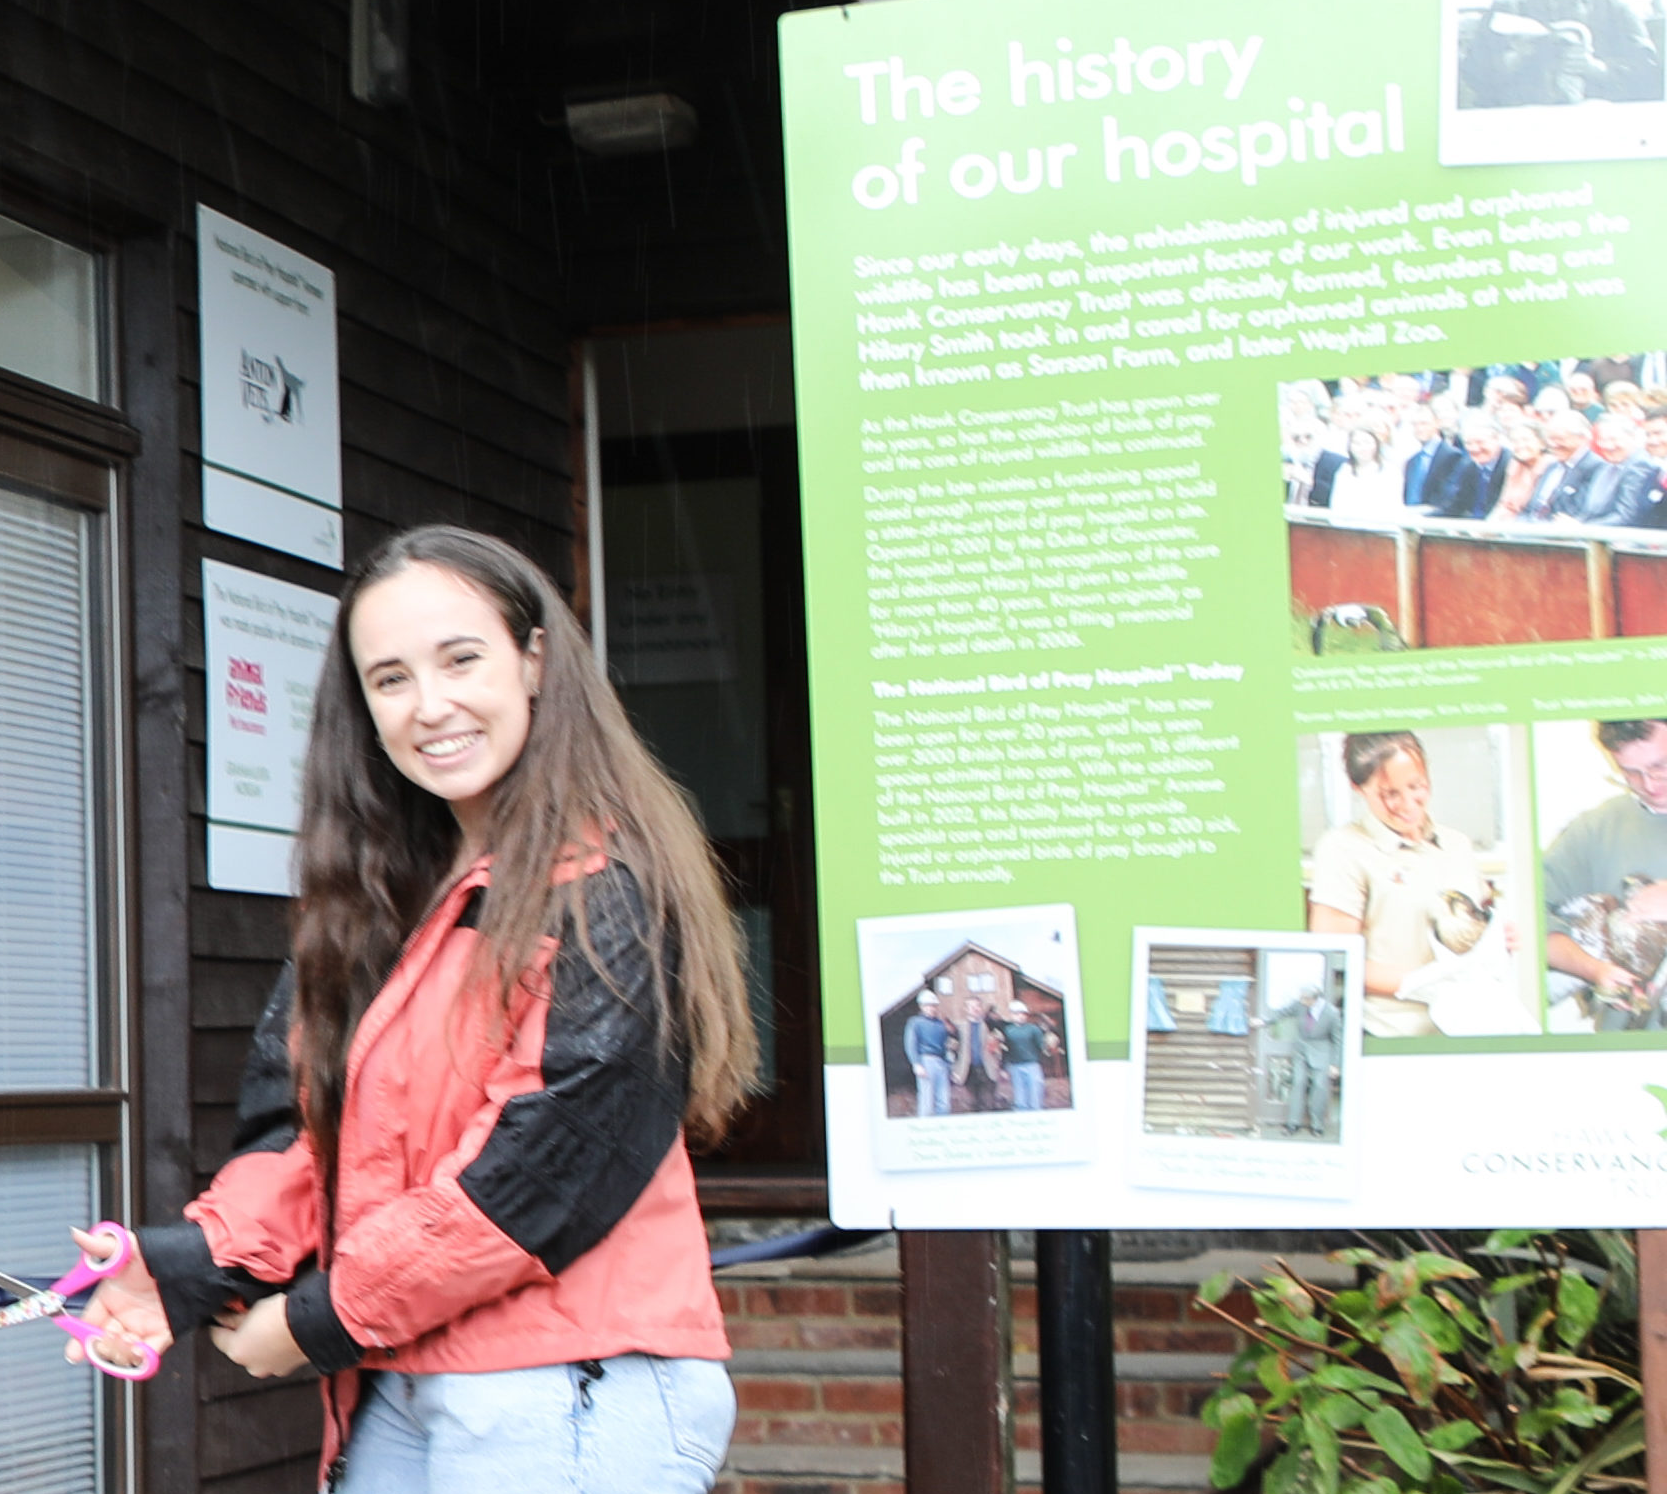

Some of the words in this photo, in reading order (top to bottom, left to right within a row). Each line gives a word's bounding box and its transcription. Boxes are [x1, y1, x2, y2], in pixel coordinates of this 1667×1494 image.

[842, 55, 982, 125] The
[1008, 35, 1265, 107] history
[850, 136, 927, 210] of
[949, 141, 1078, 199] our
[1101, 82, 1405, 187] hospital
[853, 256, 913, 278] Since
[917, 252, 957, 272] our
[962, 242, 1020, 267] early
[1088, 232, 1129, 254] the
[1291, 211, 1319, 233] of
[1323, 202, 1410, 232] injured
[1414, 197, 1465, 221] and
[1469, 184, 1594, 217] orphaned
[854, 279, 933, 306] wildlife
[937, 276, 980, 298] has
[984, 272, 1043, 293] been
[1047, 269, 1080, 287] an
[1084, 252, 1199, 284] important
[1204, 247, 1272, 272] factor
[1278, 242, 1305, 264] of
[1309, 242, 1351, 261] our
[1431, 228, 1494, 250] Even
[1498, 219, 1582, 243] before
[1588, 212, 1630, 235] the
[856, 308, 922, 334] Hawk
[926, 298, 1072, 328] Conservancy
[1078, 288, 1133, 313] Trust
[1138, 288, 1185, 307] was
[1393, 257, 1503, 284] founders
[1562, 243, 1615, 268] and
[857, 339, 925, 362] Hilary
[929, 330, 994, 356] Smith
[998, 325, 1050, 350] took
[1054, 323, 1079, 345] in
[1082, 318, 1130, 342] and
[1134, 311, 1203, 337] cared
[1206, 309, 1241, 331] for
[1246, 296, 1366, 328] orphaned
[1370, 288, 1468, 316] animals
[1471, 284, 1500, 306] at
[1505, 277, 1569, 303] what
[1575, 277, 1626, 297] was
[858, 369, 910, 392] then
[914, 364, 991, 386] known
[994, 361, 1023, 379] as
[1184, 337, 1234, 362] and
[1238, 334, 1294, 357] later
